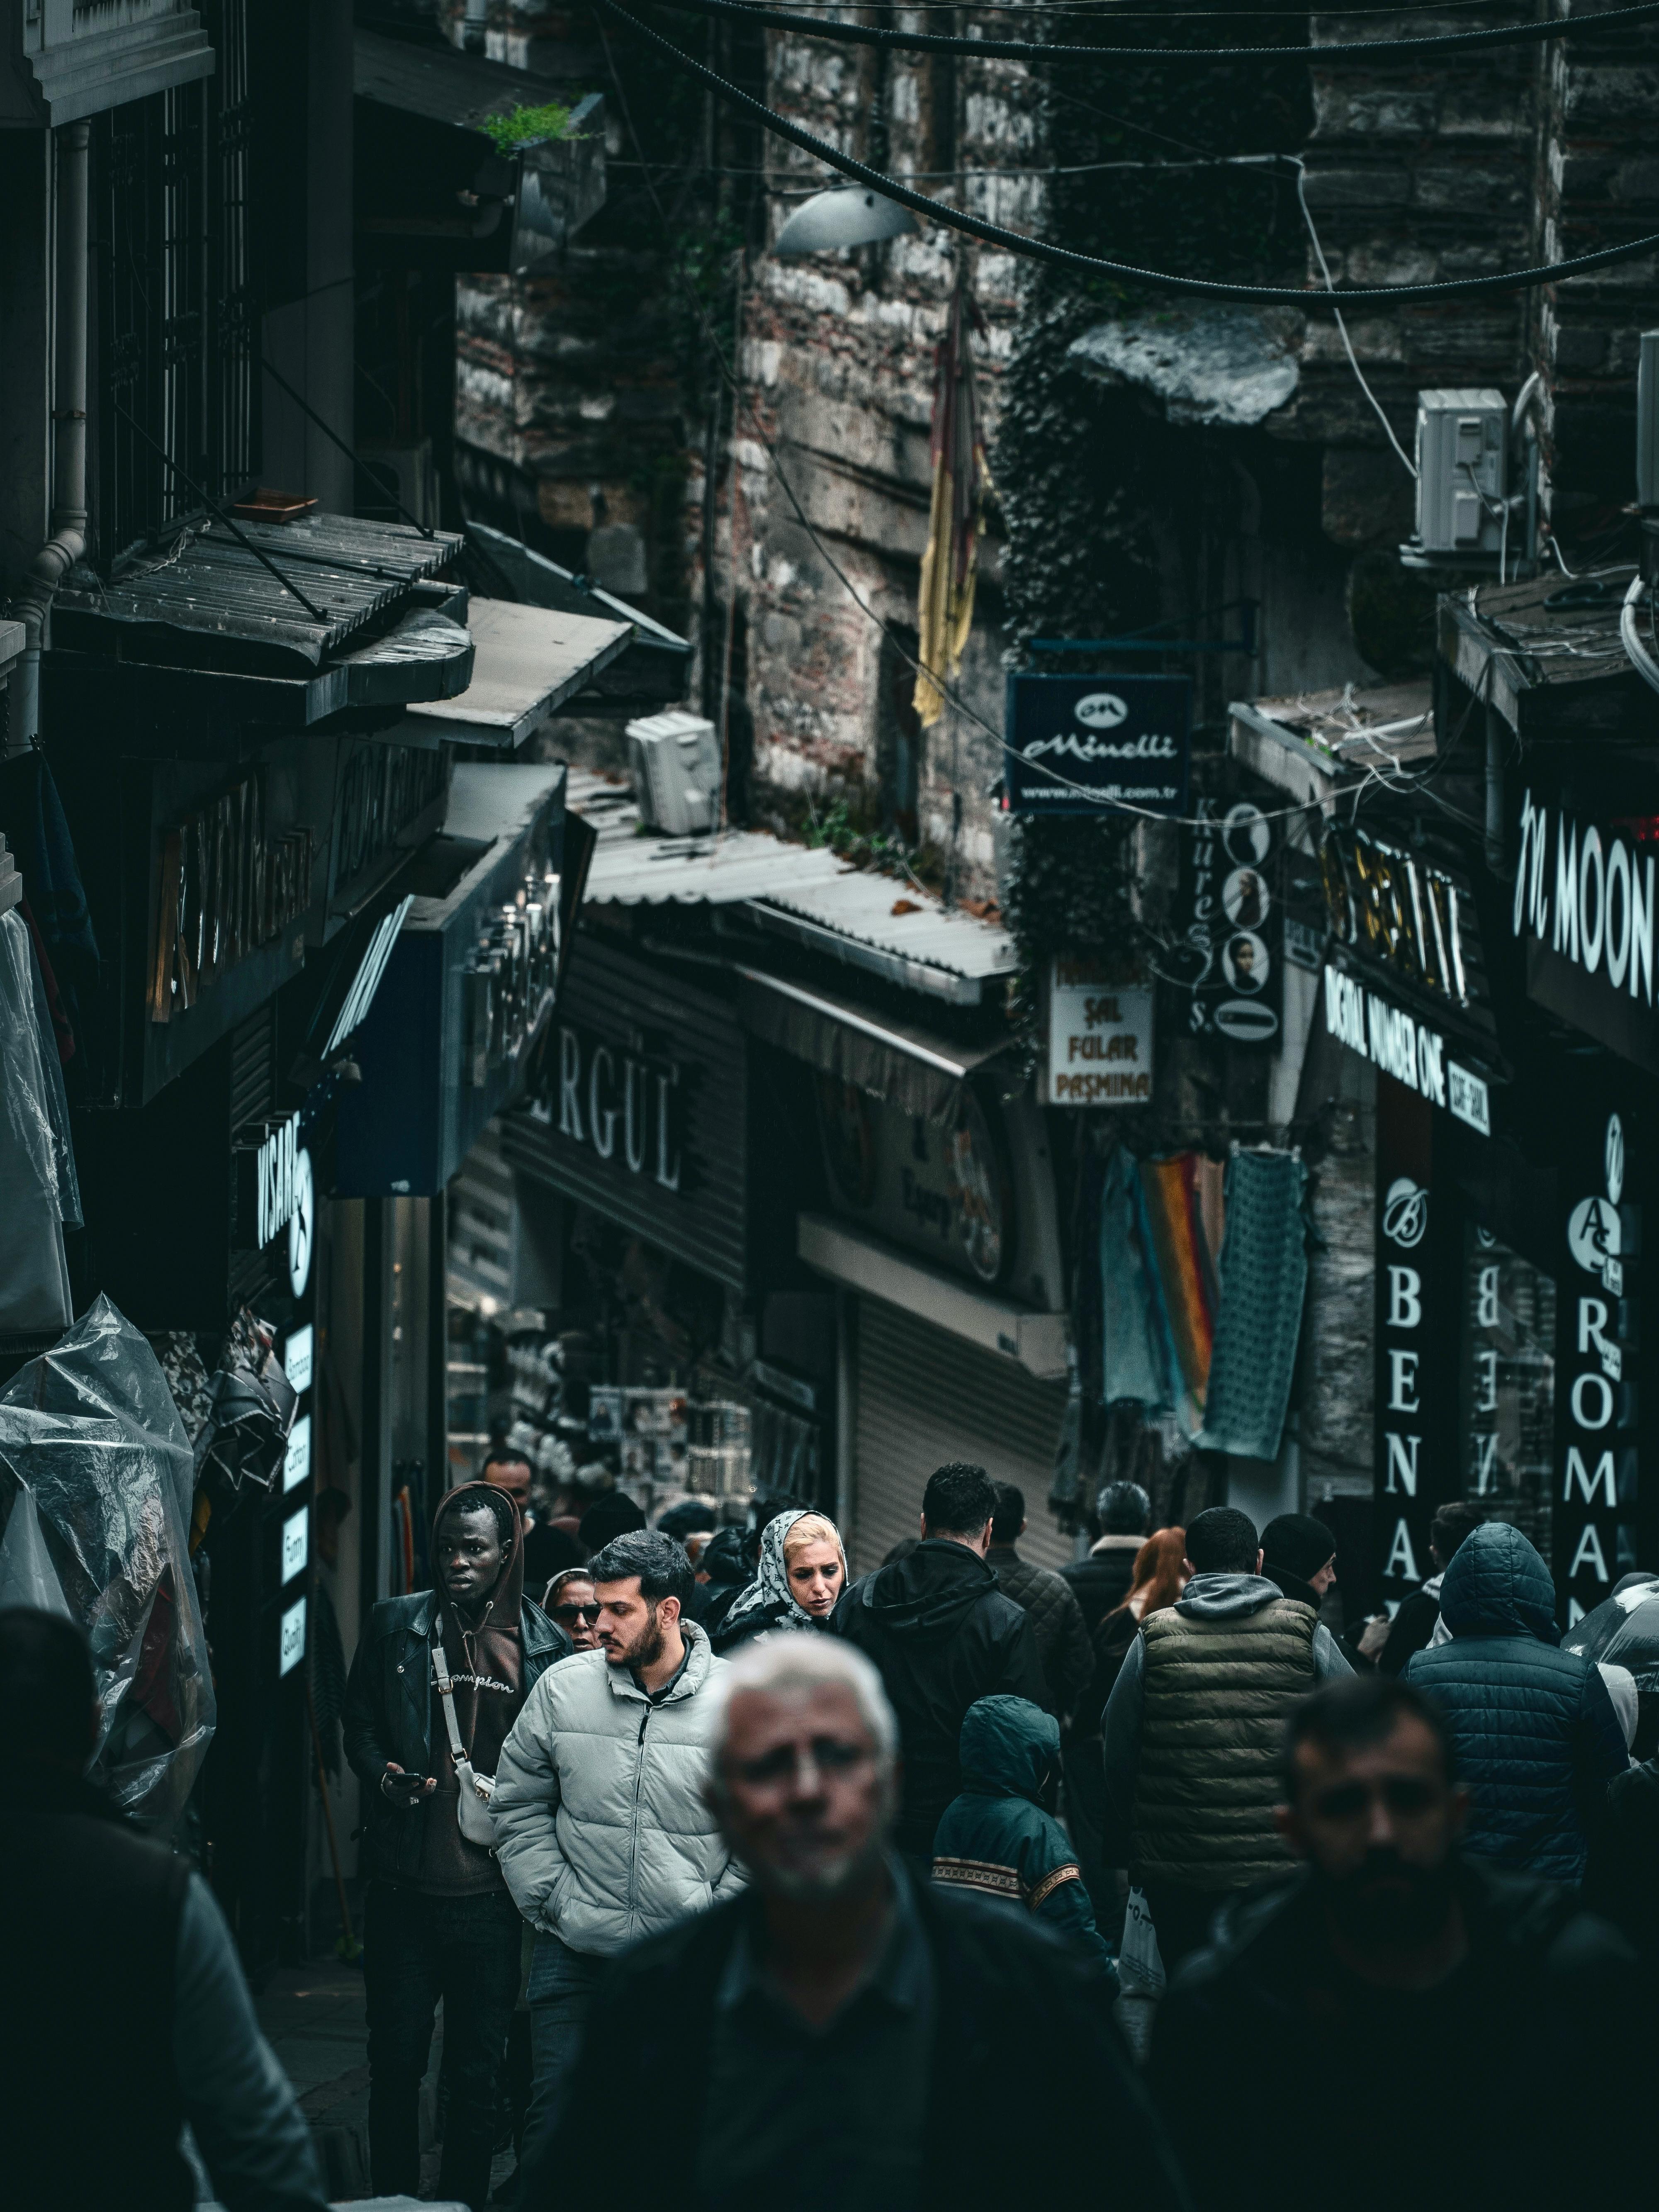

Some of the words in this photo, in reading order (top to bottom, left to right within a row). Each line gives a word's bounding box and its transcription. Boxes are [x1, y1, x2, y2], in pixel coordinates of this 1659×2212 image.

[1021, 733, 1178, 762] Minelli
[1553, 810, 1655, 1009] MOON
[1068, 1035, 1138, 1063] FULAR
[1417, 1025, 1446, 1108] ONE
[288, 1443, 307, 1472] Cotton
[431, 1665, 514, 1694] ampion
